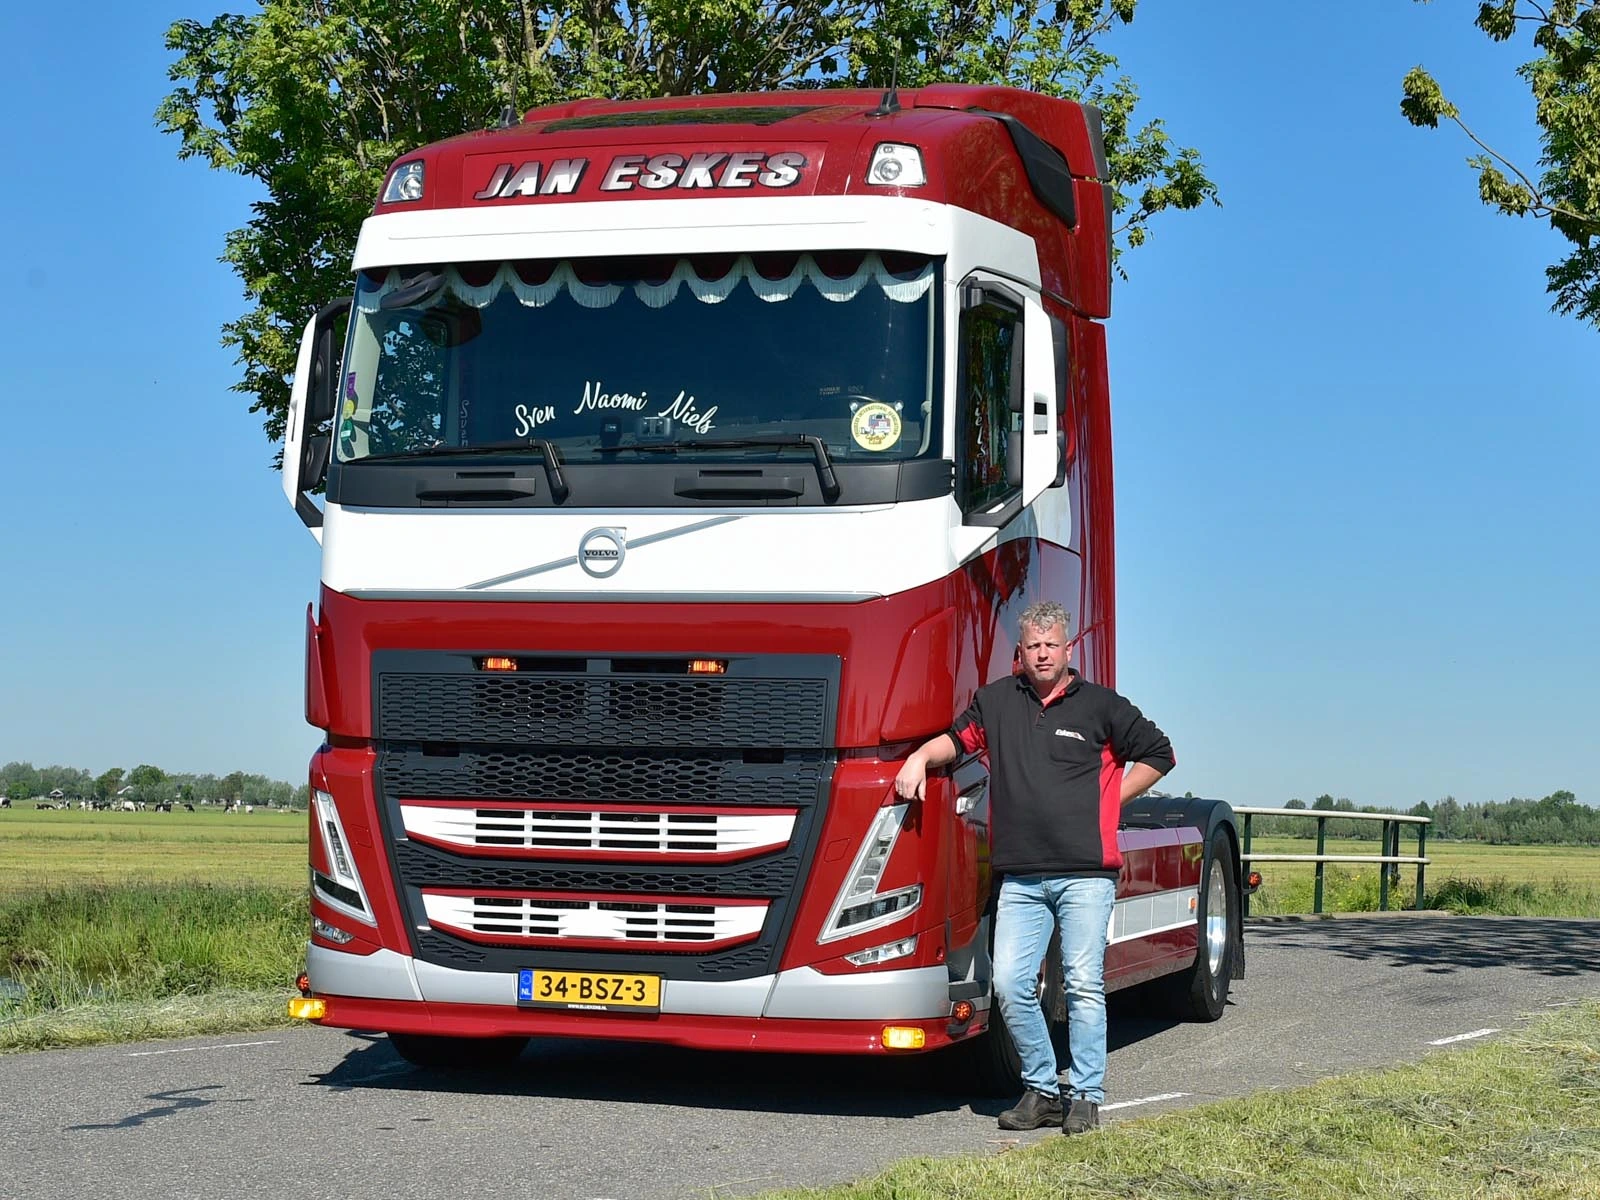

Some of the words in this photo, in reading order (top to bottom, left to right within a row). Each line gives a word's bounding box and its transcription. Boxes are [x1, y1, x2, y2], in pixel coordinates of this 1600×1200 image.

[473, 158, 590, 200] JAN
[599, 152, 808, 191] ESKES
[514, 404, 556, 437] Sven
[573, 381, 648, 415] Naomi
[657, 390, 719, 434] Niels
[521, 988, 531, 996] NL
[540, 975, 646, 1001] 34-BSZ-3
